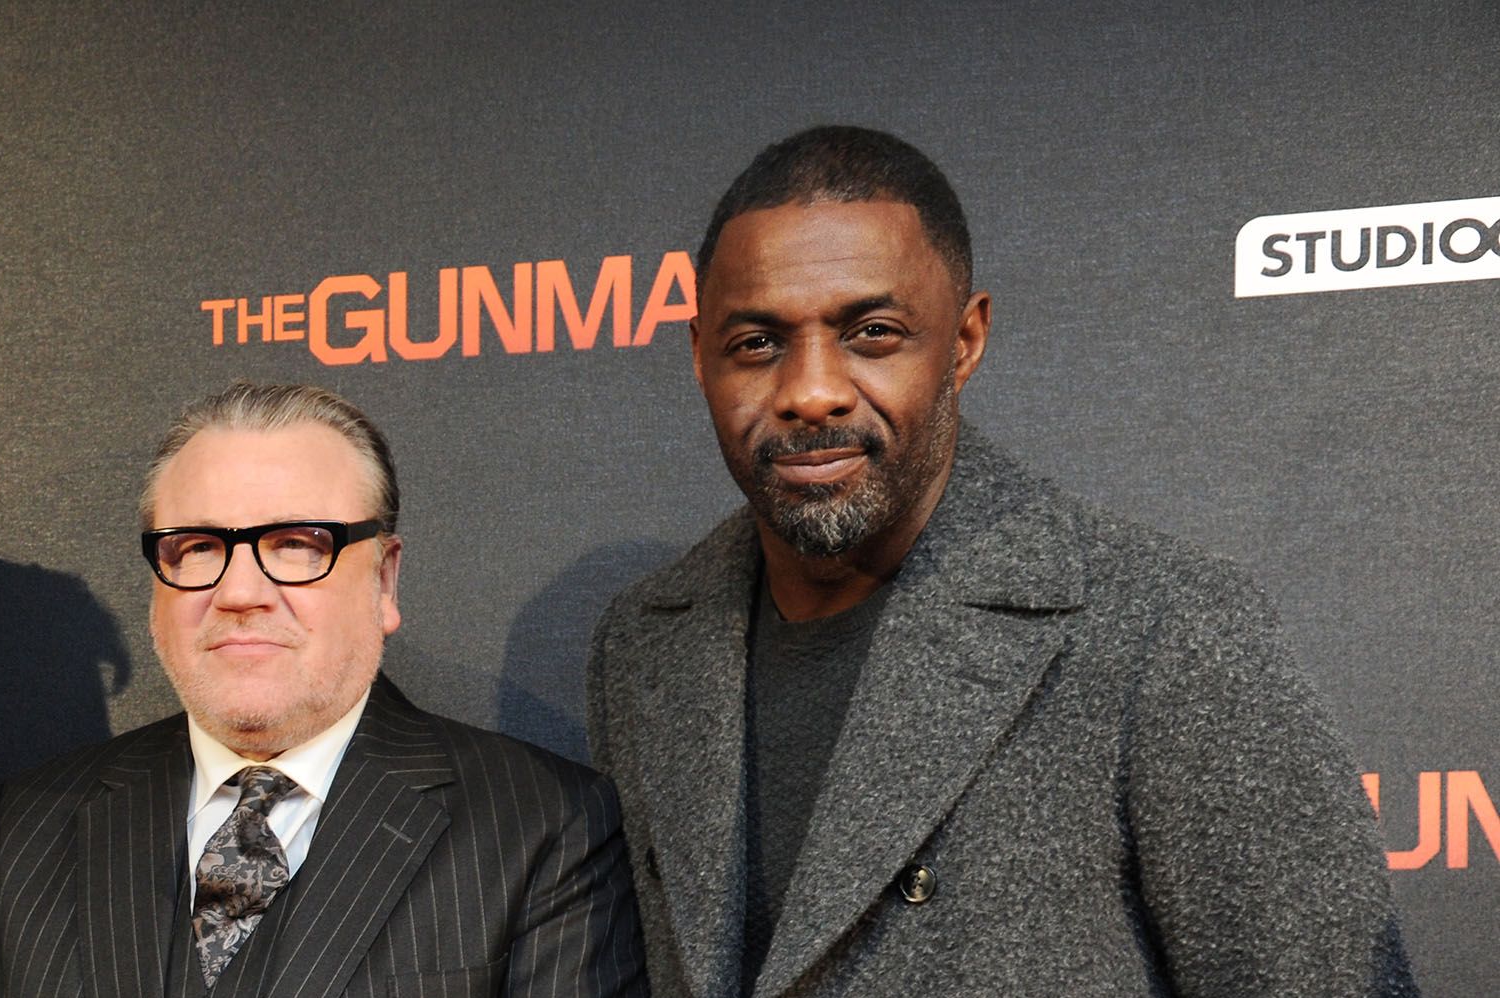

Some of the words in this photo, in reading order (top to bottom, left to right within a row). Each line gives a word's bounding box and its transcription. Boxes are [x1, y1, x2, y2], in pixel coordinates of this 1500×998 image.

[1261, 217, 1500, 278] STUDIO
[201, 293, 304, 345] THE
[309, 250, 698, 366] GUNMA
